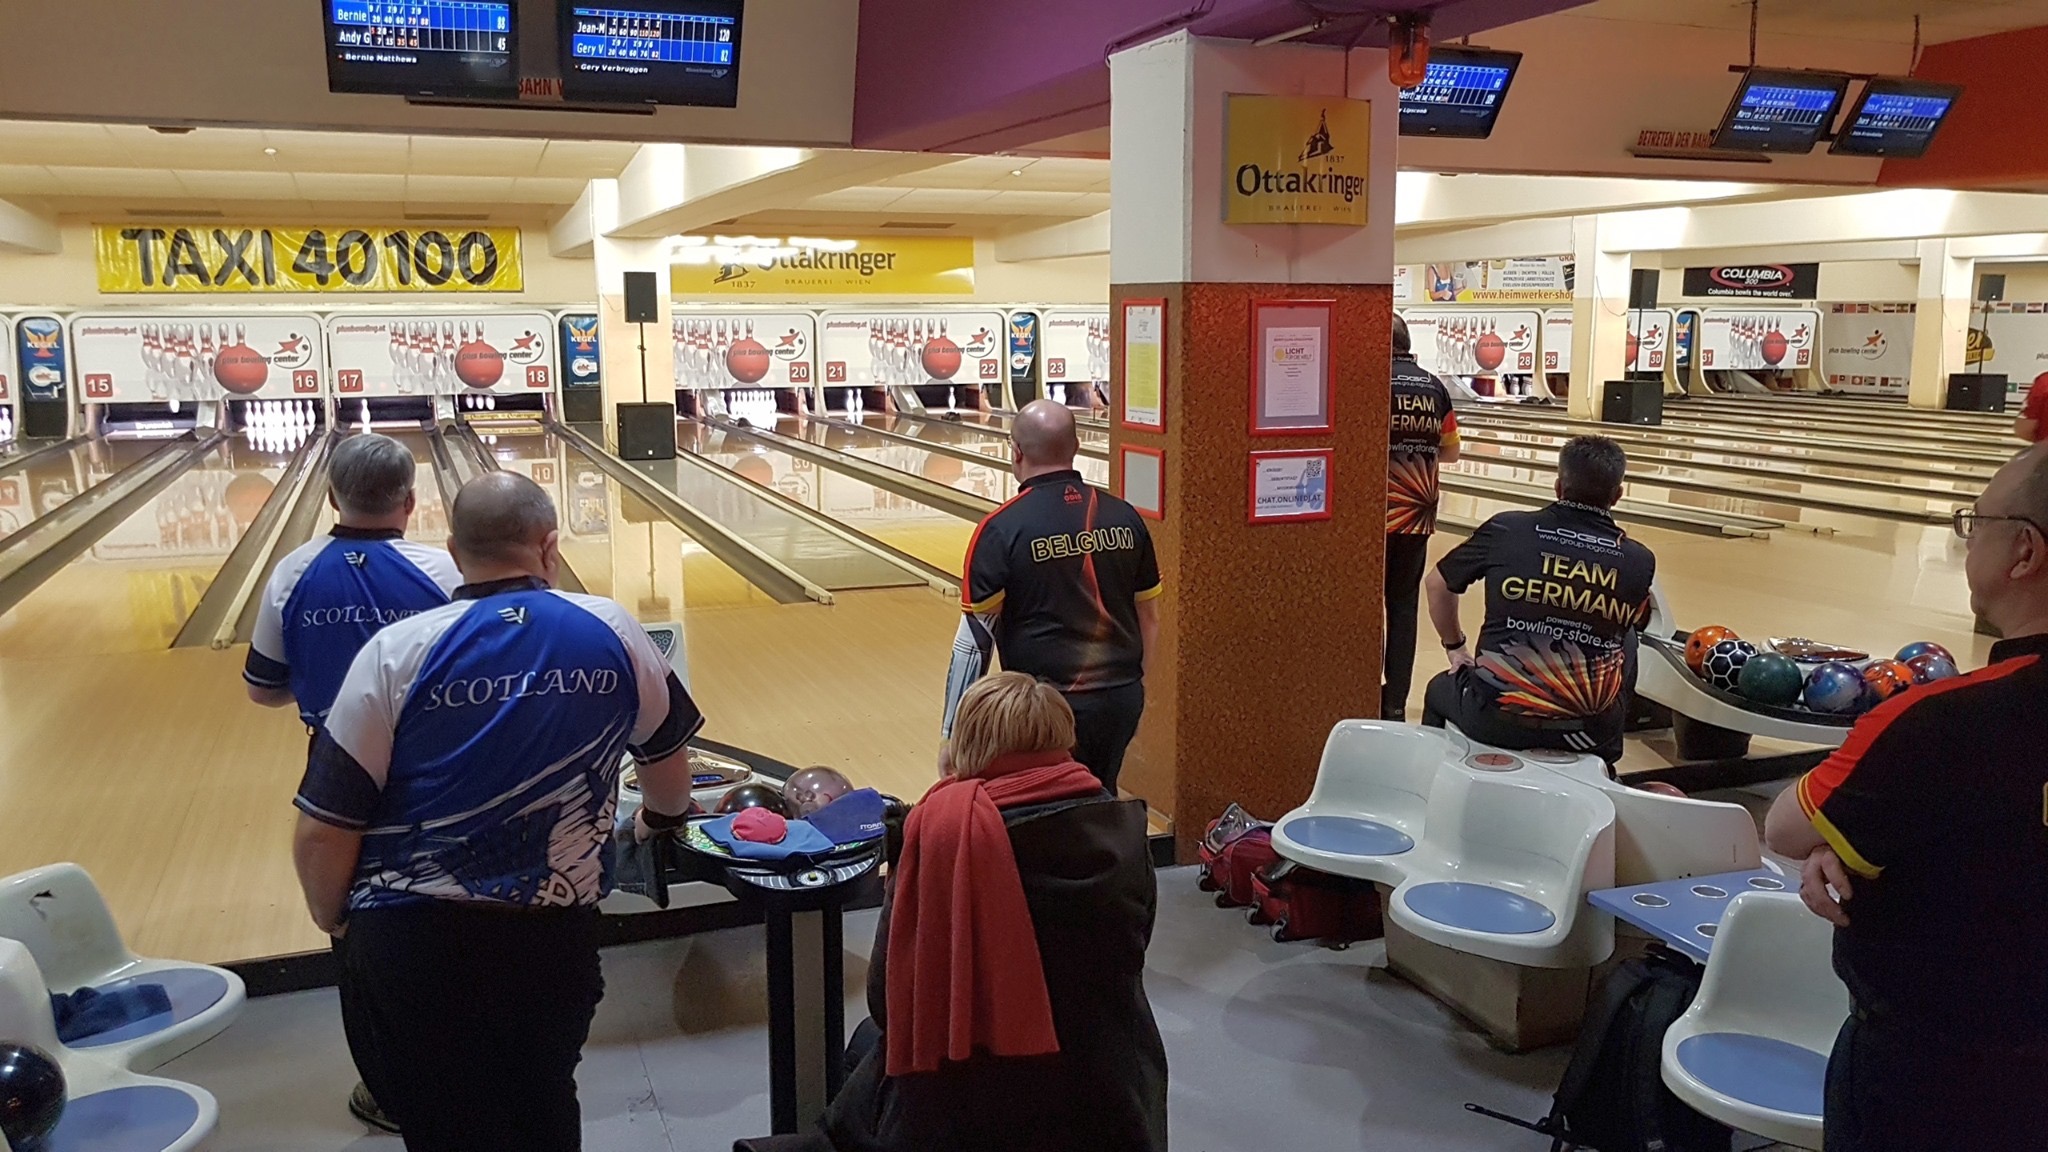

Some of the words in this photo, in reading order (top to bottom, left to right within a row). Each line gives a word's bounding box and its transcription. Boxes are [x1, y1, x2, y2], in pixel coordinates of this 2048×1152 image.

[1637, 129, 1675, 148] BETRETEN
[1675, 131, 1691, 148] DER
[1236, 163, 1364, 203] Ottakringer
[121, 228, 276, 286] TAXI
[292, 229, 379, 286] 40
[384, 229, 497, 286] 100
[757, 246, 896, 277] ttakringer
[1721, 268, 1782, 280] COLUMBIA
[731, 281, 756, 289] 1837
[1707, 288, 1734, 296] Columbia
[273, 355, 299, 363] center
[509, 351, 532, 359] center
[1520, 356, 1531, 365] 28
[1545, 356, 1557, 365] 29
[1651, 355, 1661, 363] 30
[1703, 353, 1711, 362] 31
[1798, 353, 1807, 361] 32
[791, 367, 807, 377] 20
[829, 366, 844, 377] 21
[981, 364, 996, 374] 22
[1050, 363, 1064, 373] 23
[295, 375, 314, 388] 16
[341, 374, 358, 387] 17
[528, 370, 545, 382] 18
[88, 379, 109, 392] 15
[1395, 394, 1435, 413] TEAM
[1391, 415, 1441, 434] ERMAN
[1031, 527, 1134, 562] BELGIUM
[1538, 533, 1625, 558] www.group-logo.com
[1540, 551, 1618, 591] TEAM
[1501, 577, 1637, 627] GERMANY
[1546, 615, 1581, 629] powered
[1582, 620, 1593, 631] by
[424, 668, 618, 711] SCOTLAND
